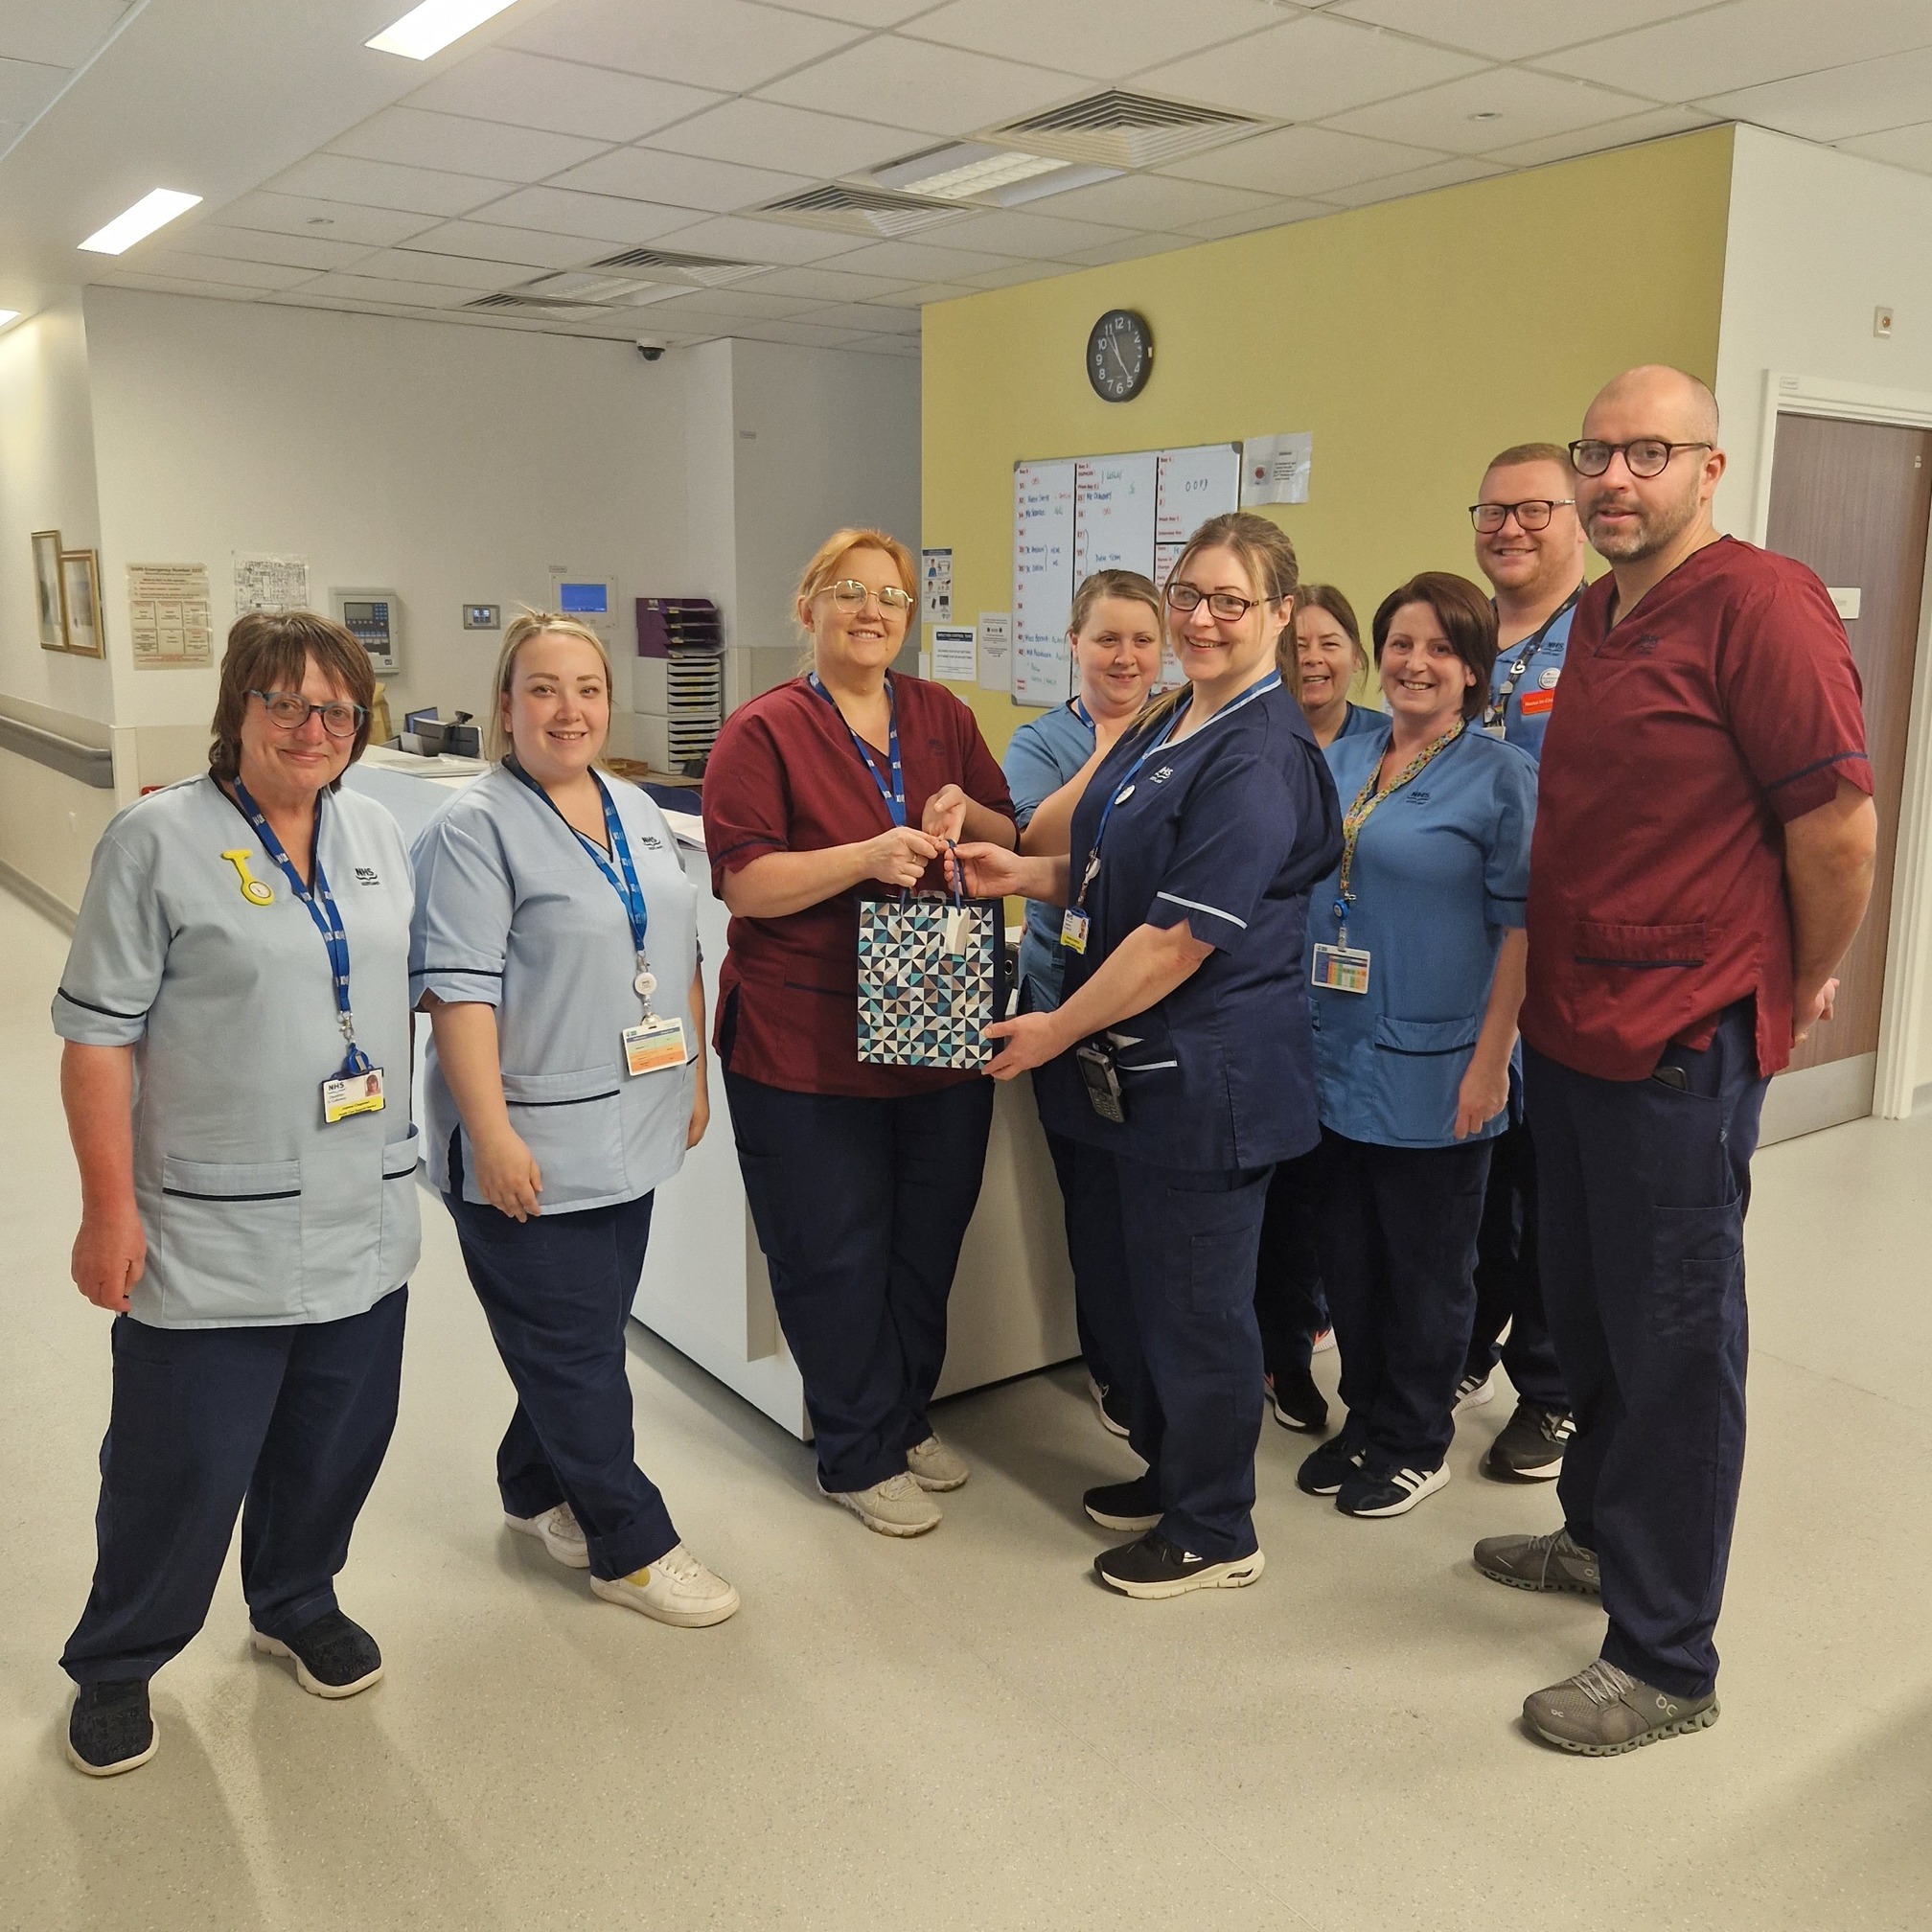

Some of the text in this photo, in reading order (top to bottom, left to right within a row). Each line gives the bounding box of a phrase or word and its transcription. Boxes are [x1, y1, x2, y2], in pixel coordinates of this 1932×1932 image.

[1105, 323, 1113, 336] 11
[1115, 317, 1124, 330] 12
[1127, 319, 1131, 332] 1
[1134, 331, 1141, 343] 2
[1097, 338, 1107, 350] 10
[1095, 354, 1103, 366] 9
[1134, 361, 1140, 373] 4
[1098, 368, 1106, 380] 8
[1107, 379, 1114, 391] 7
[1116, 382, 1124, 394] 6
[1127, 376, 1134, 388] 5
[355, 866, 375, 877] NHS
[328, 1081, 345, 1092] NHS
